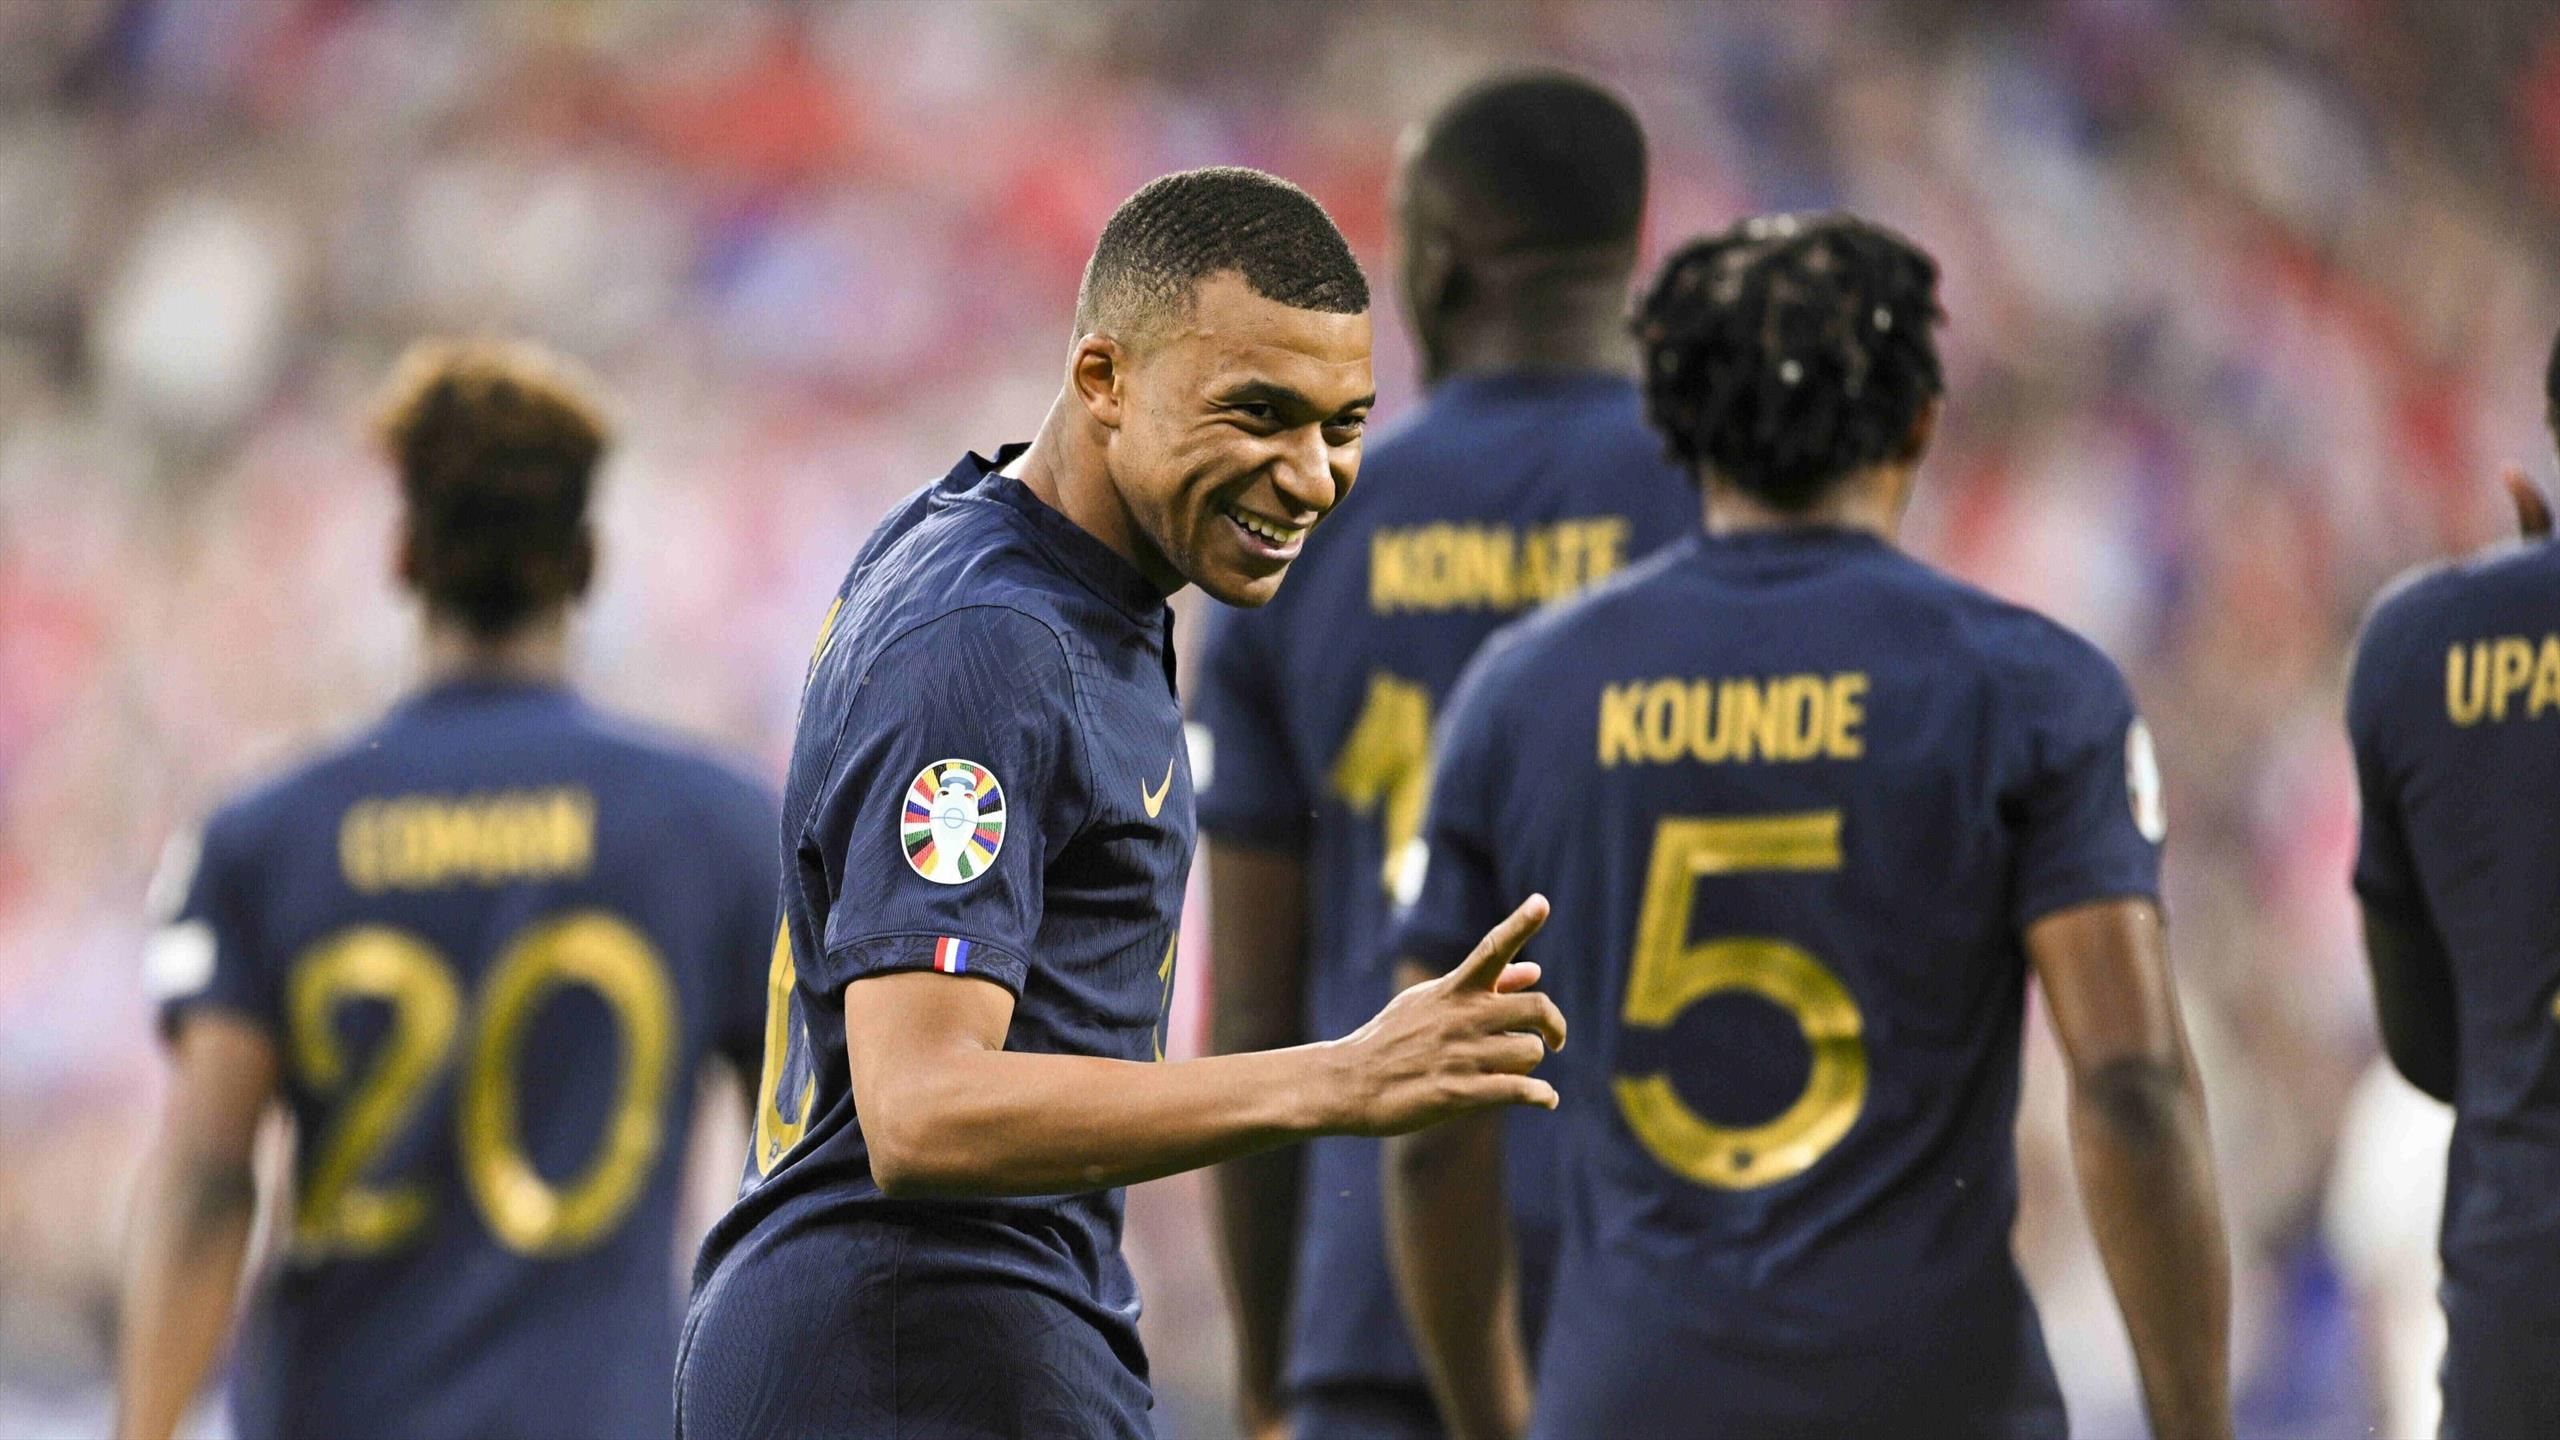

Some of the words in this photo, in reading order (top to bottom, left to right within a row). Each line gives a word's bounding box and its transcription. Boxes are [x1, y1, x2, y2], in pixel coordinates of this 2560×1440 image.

[1598, 673, 1867, 765] KOUNDE
[287, 911, 677, 1257] 20
[1613, 809, 1868, 1190] 5
